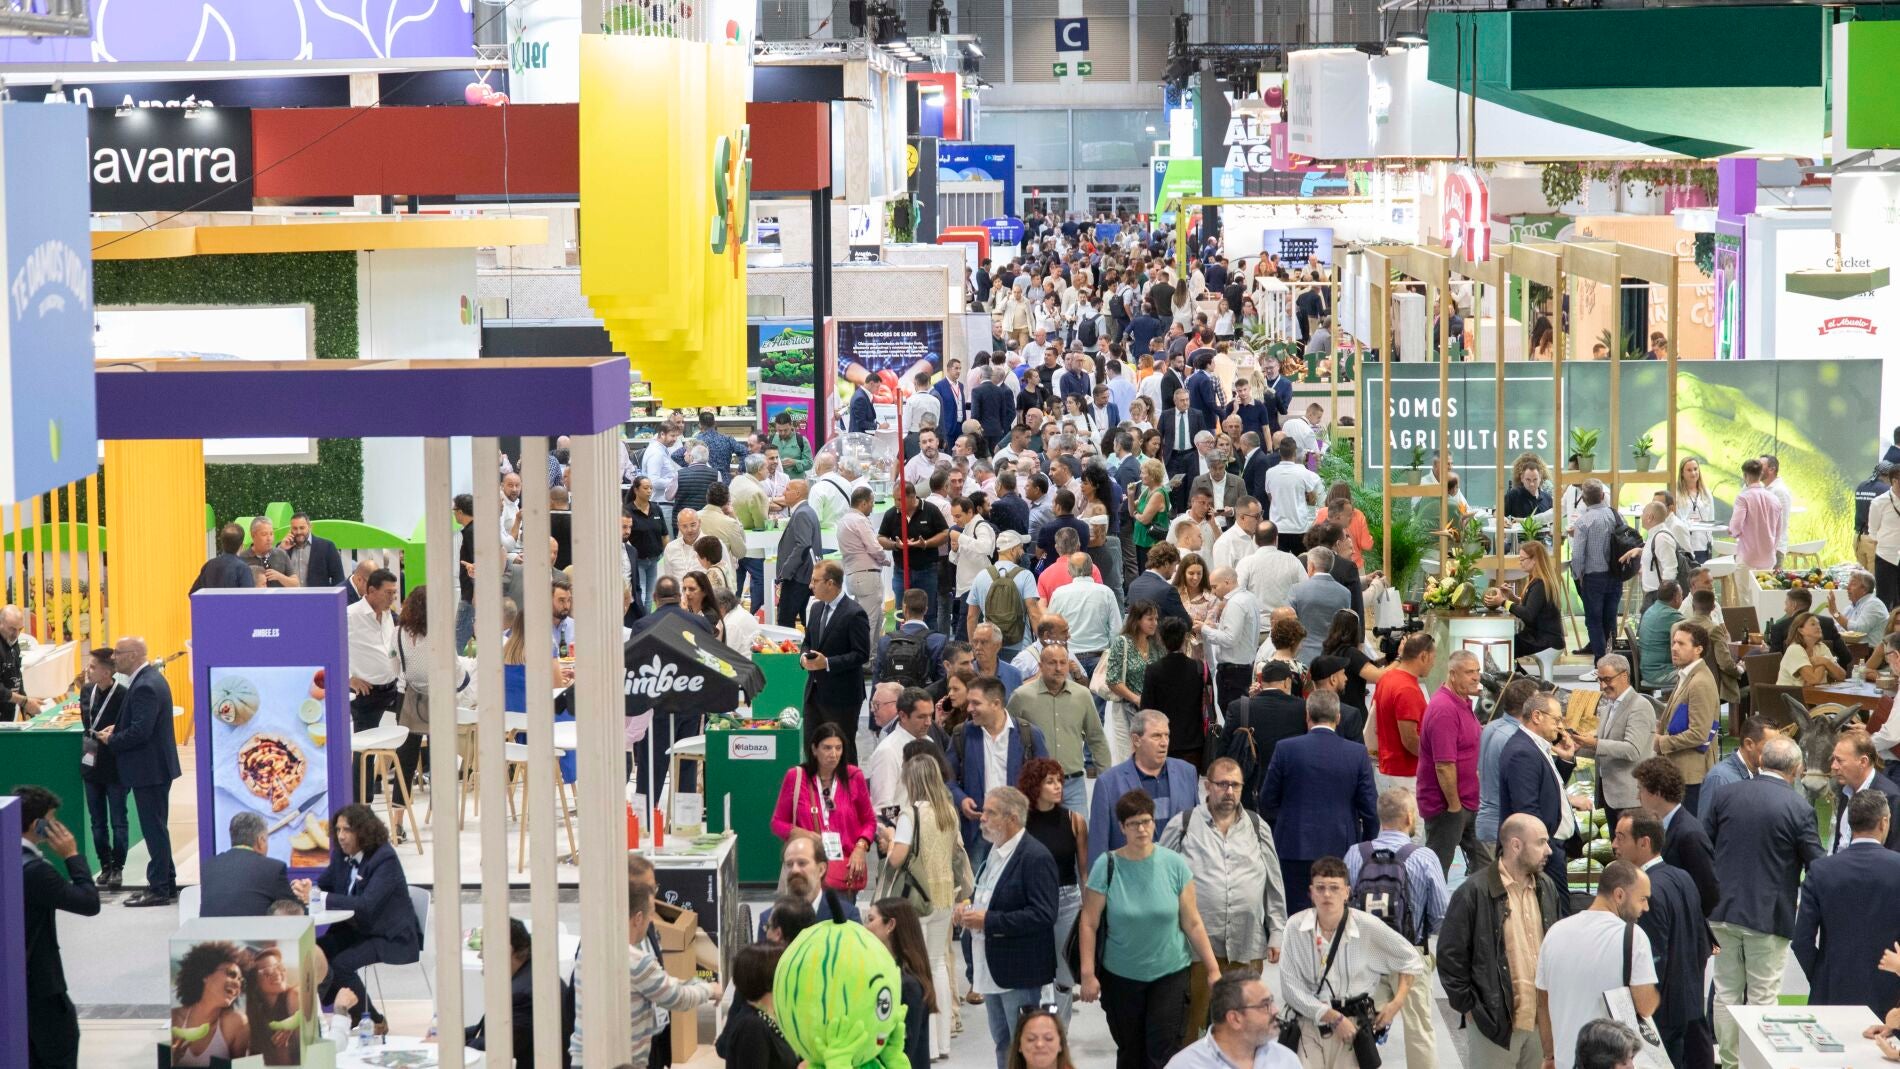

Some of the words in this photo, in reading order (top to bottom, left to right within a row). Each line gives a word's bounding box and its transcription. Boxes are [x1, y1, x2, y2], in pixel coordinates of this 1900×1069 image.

[1063, 22, 1081, 46] C
[87, 137, 237, 183] avarra
[1826, 257, 1871, 268] Cicket
[1390, 429, 1548, 449] AGRIULTRES
